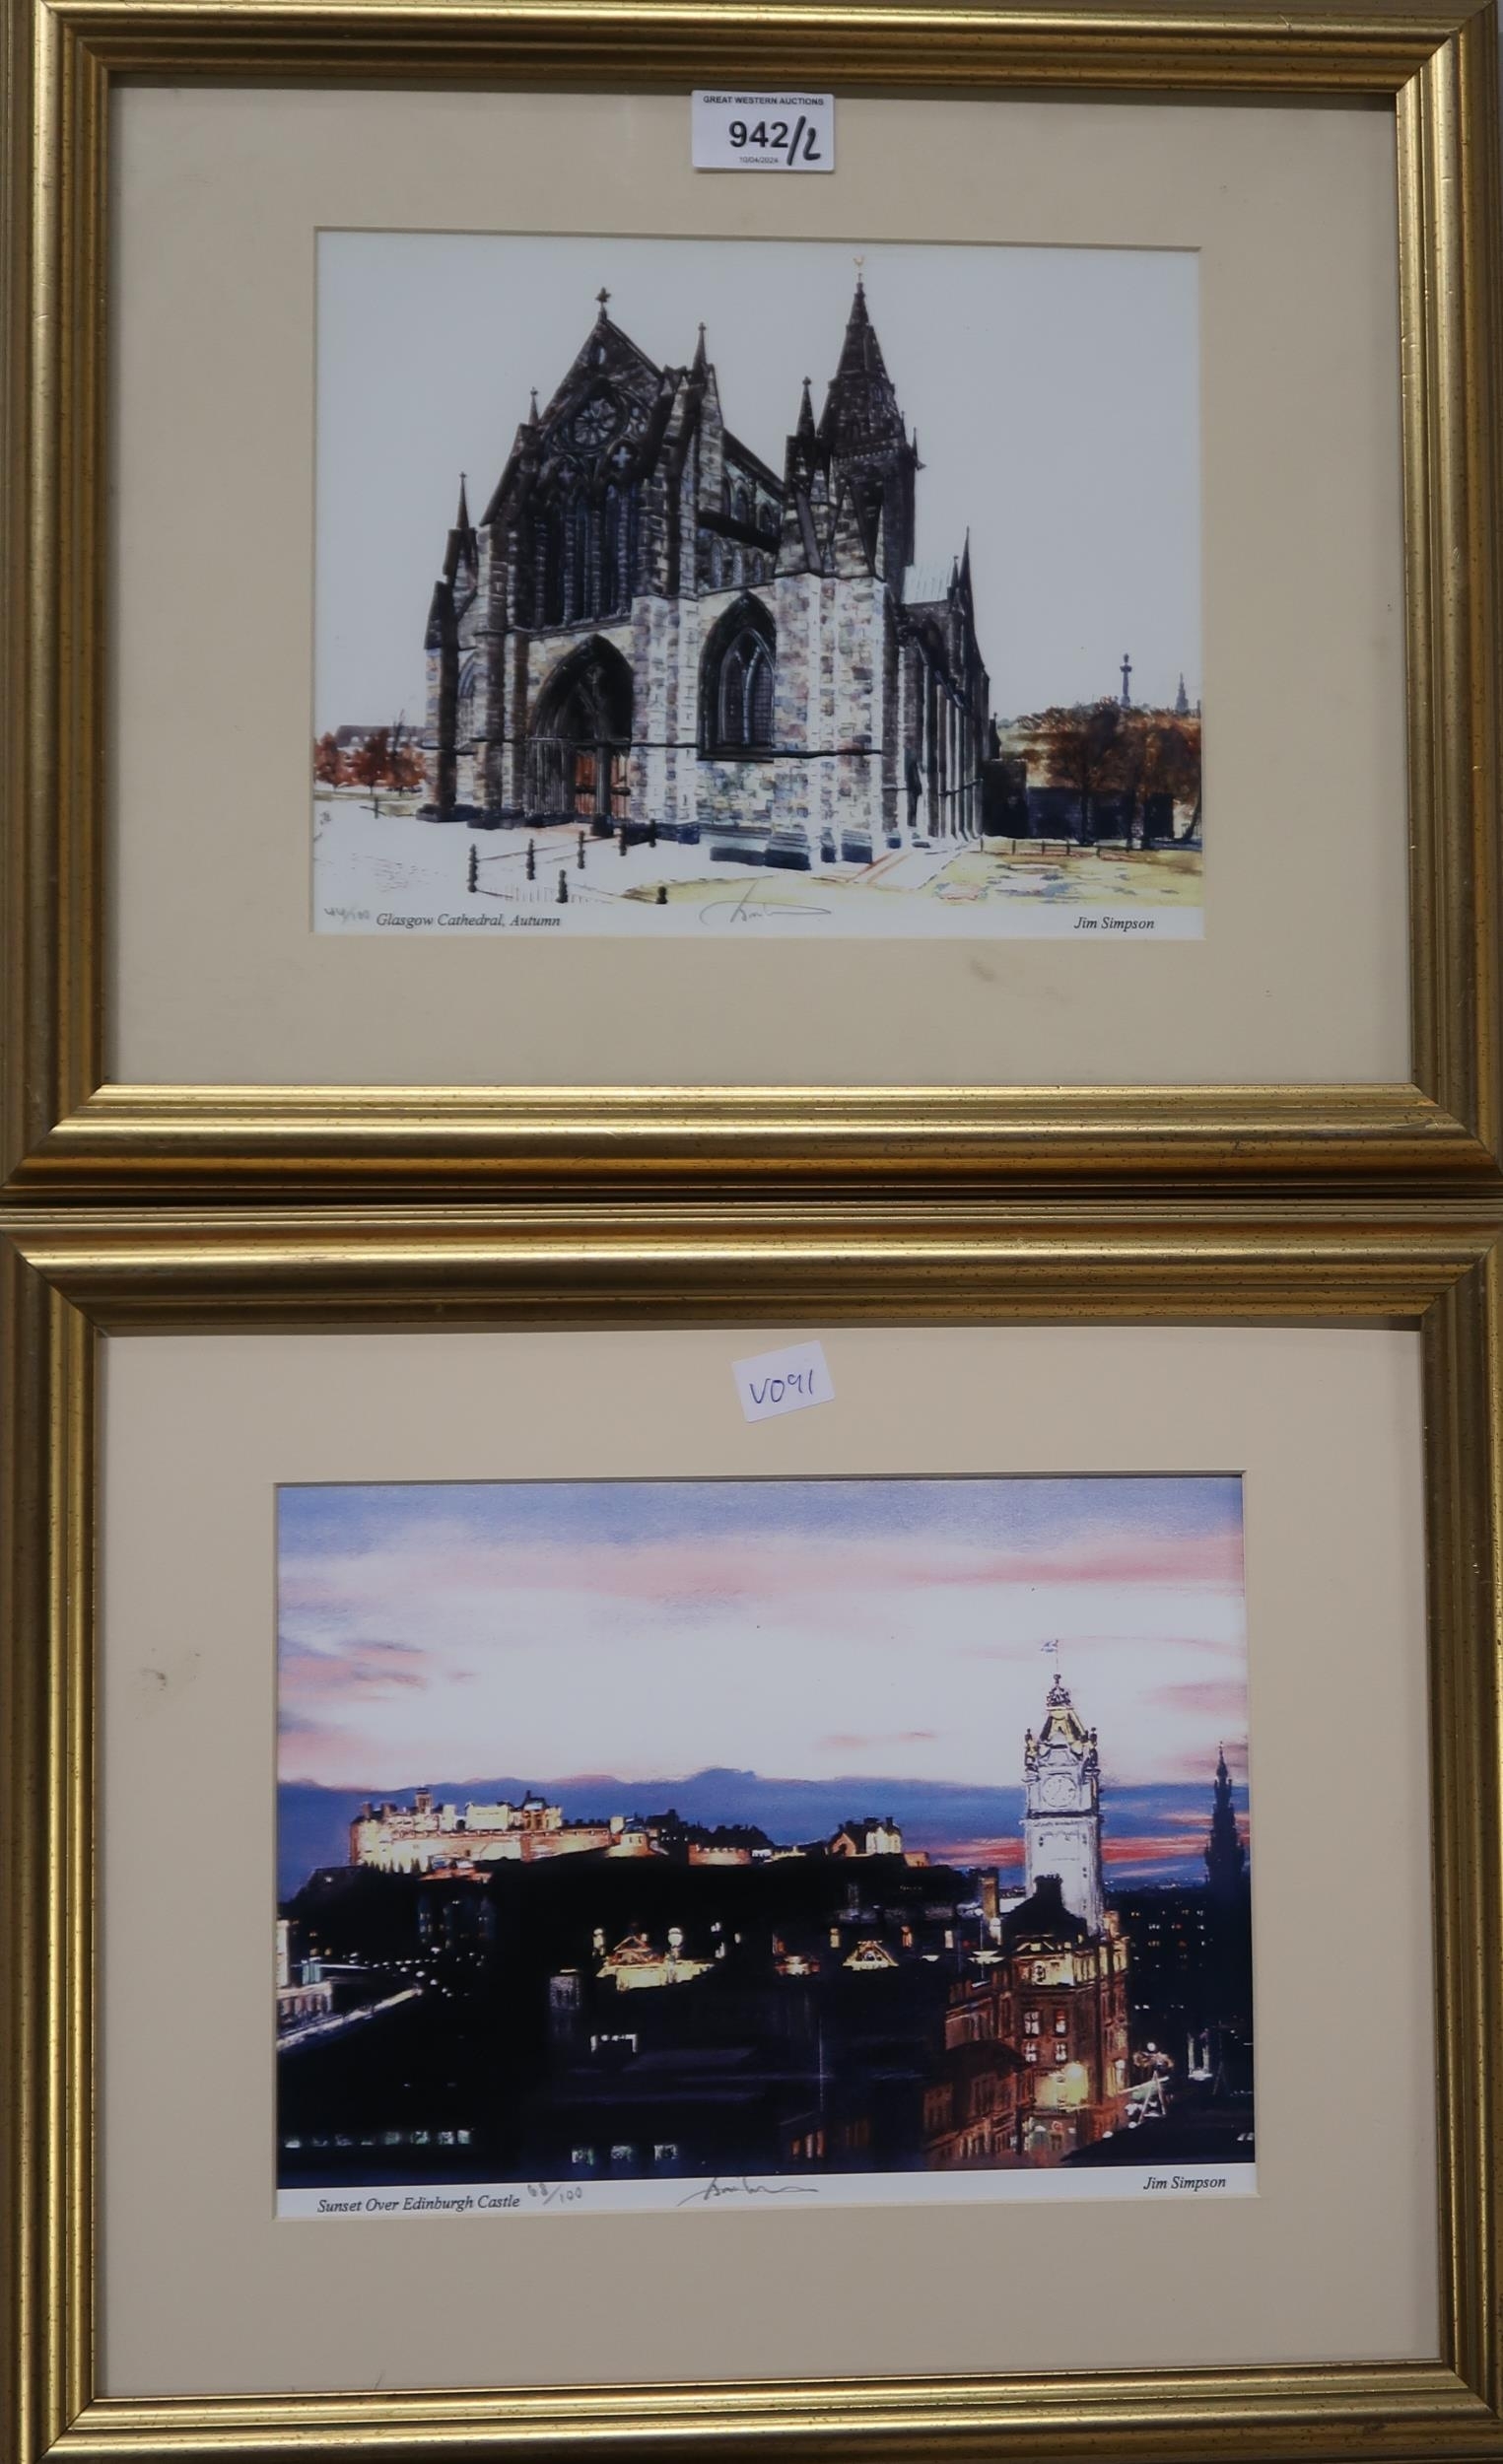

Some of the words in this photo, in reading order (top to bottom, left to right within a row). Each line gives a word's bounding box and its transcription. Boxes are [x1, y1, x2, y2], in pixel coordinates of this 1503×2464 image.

[703, 95, 733, 103] GREAT
[734, 96, 778, 104] WESTERN
[779, 97, 825, 105] AUCTIONS
[376, 913, 434, 928] Glasgow
[437, 913, 506, 928] Cathedral,
[509, 914, 561, 926] Autumn
[1073, 916, 1098, 929] Jim
[1101, 916, 1155, 932] Simpson
[1143, 2176, 1168, 2190] Jim
[1170, 2175, 1226, 2192] Simpson
[316, 2199, 362, 2213] Sunset
[365, 2198, 399, 2212] Over
[402, 2195, 473, 2212] Edinburgh
[477, 2194, 520, 2209] Castle
